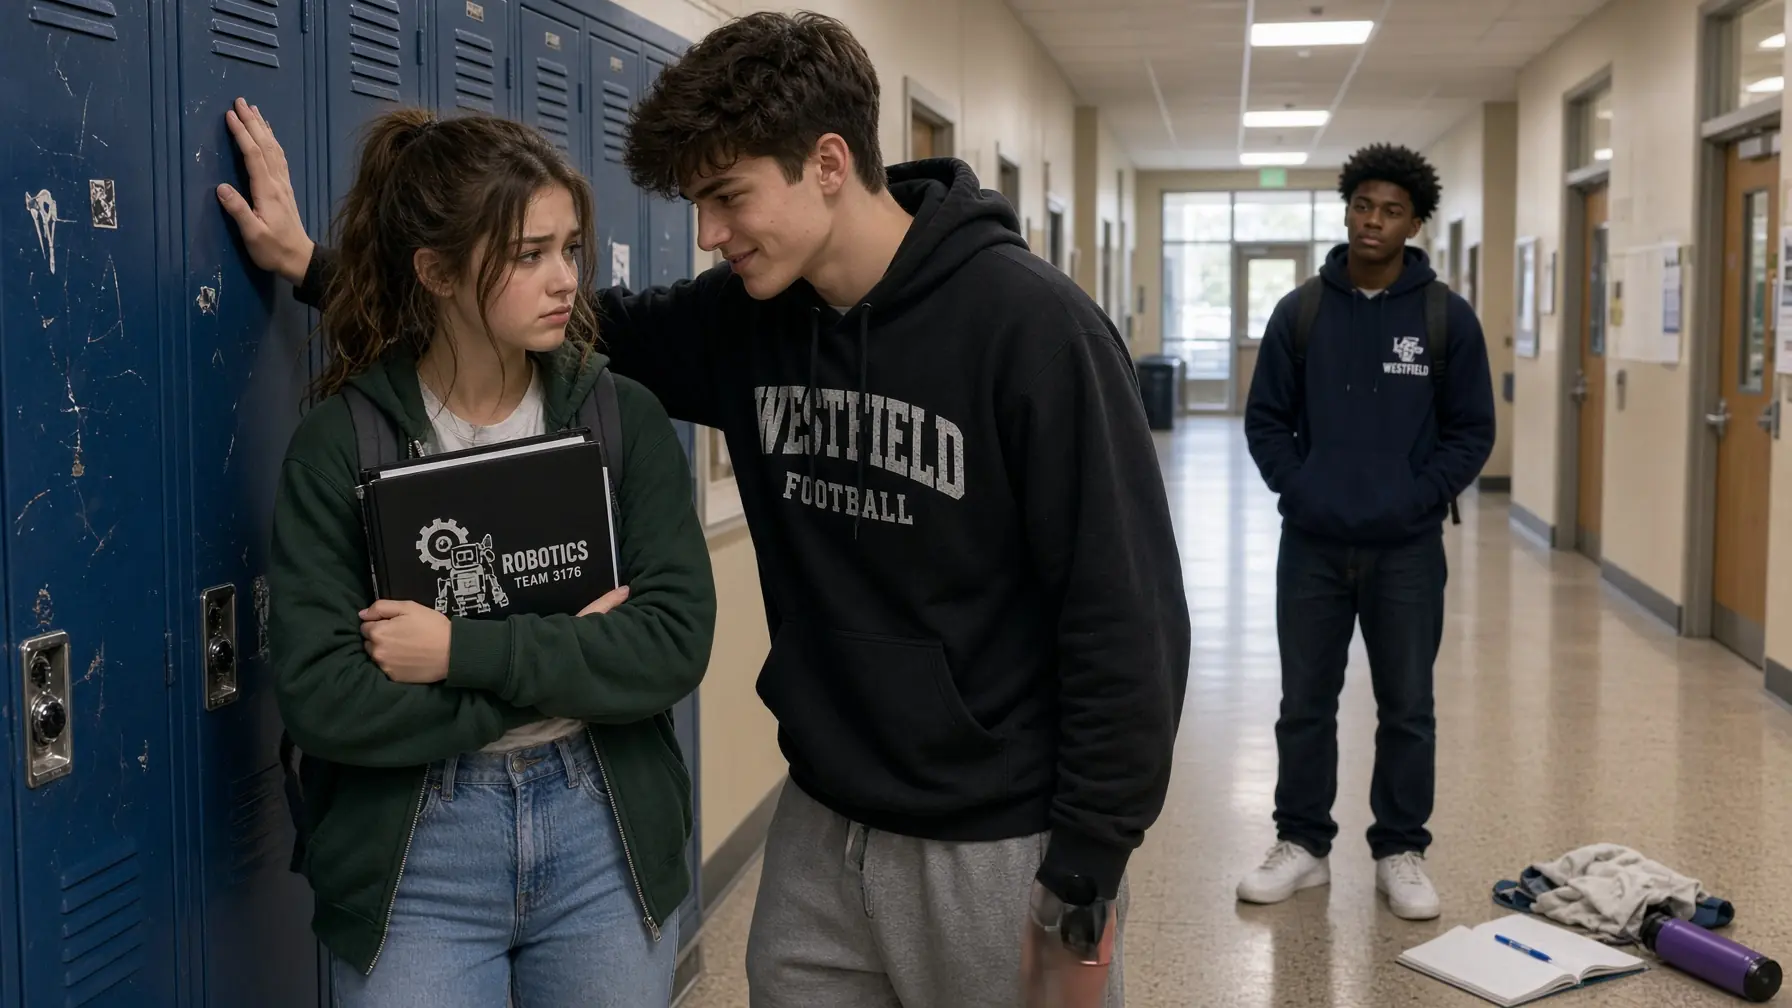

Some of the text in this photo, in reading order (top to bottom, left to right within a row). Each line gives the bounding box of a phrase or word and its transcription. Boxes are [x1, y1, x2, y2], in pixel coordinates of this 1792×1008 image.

[1383, 362, 1429, 376] WESTFIELD
[783, 471, 913, 525] FOOTBALL
[502, 540, 589, 574] ROBOTICS
[514, 566, 582, 589] TEAM 3176
